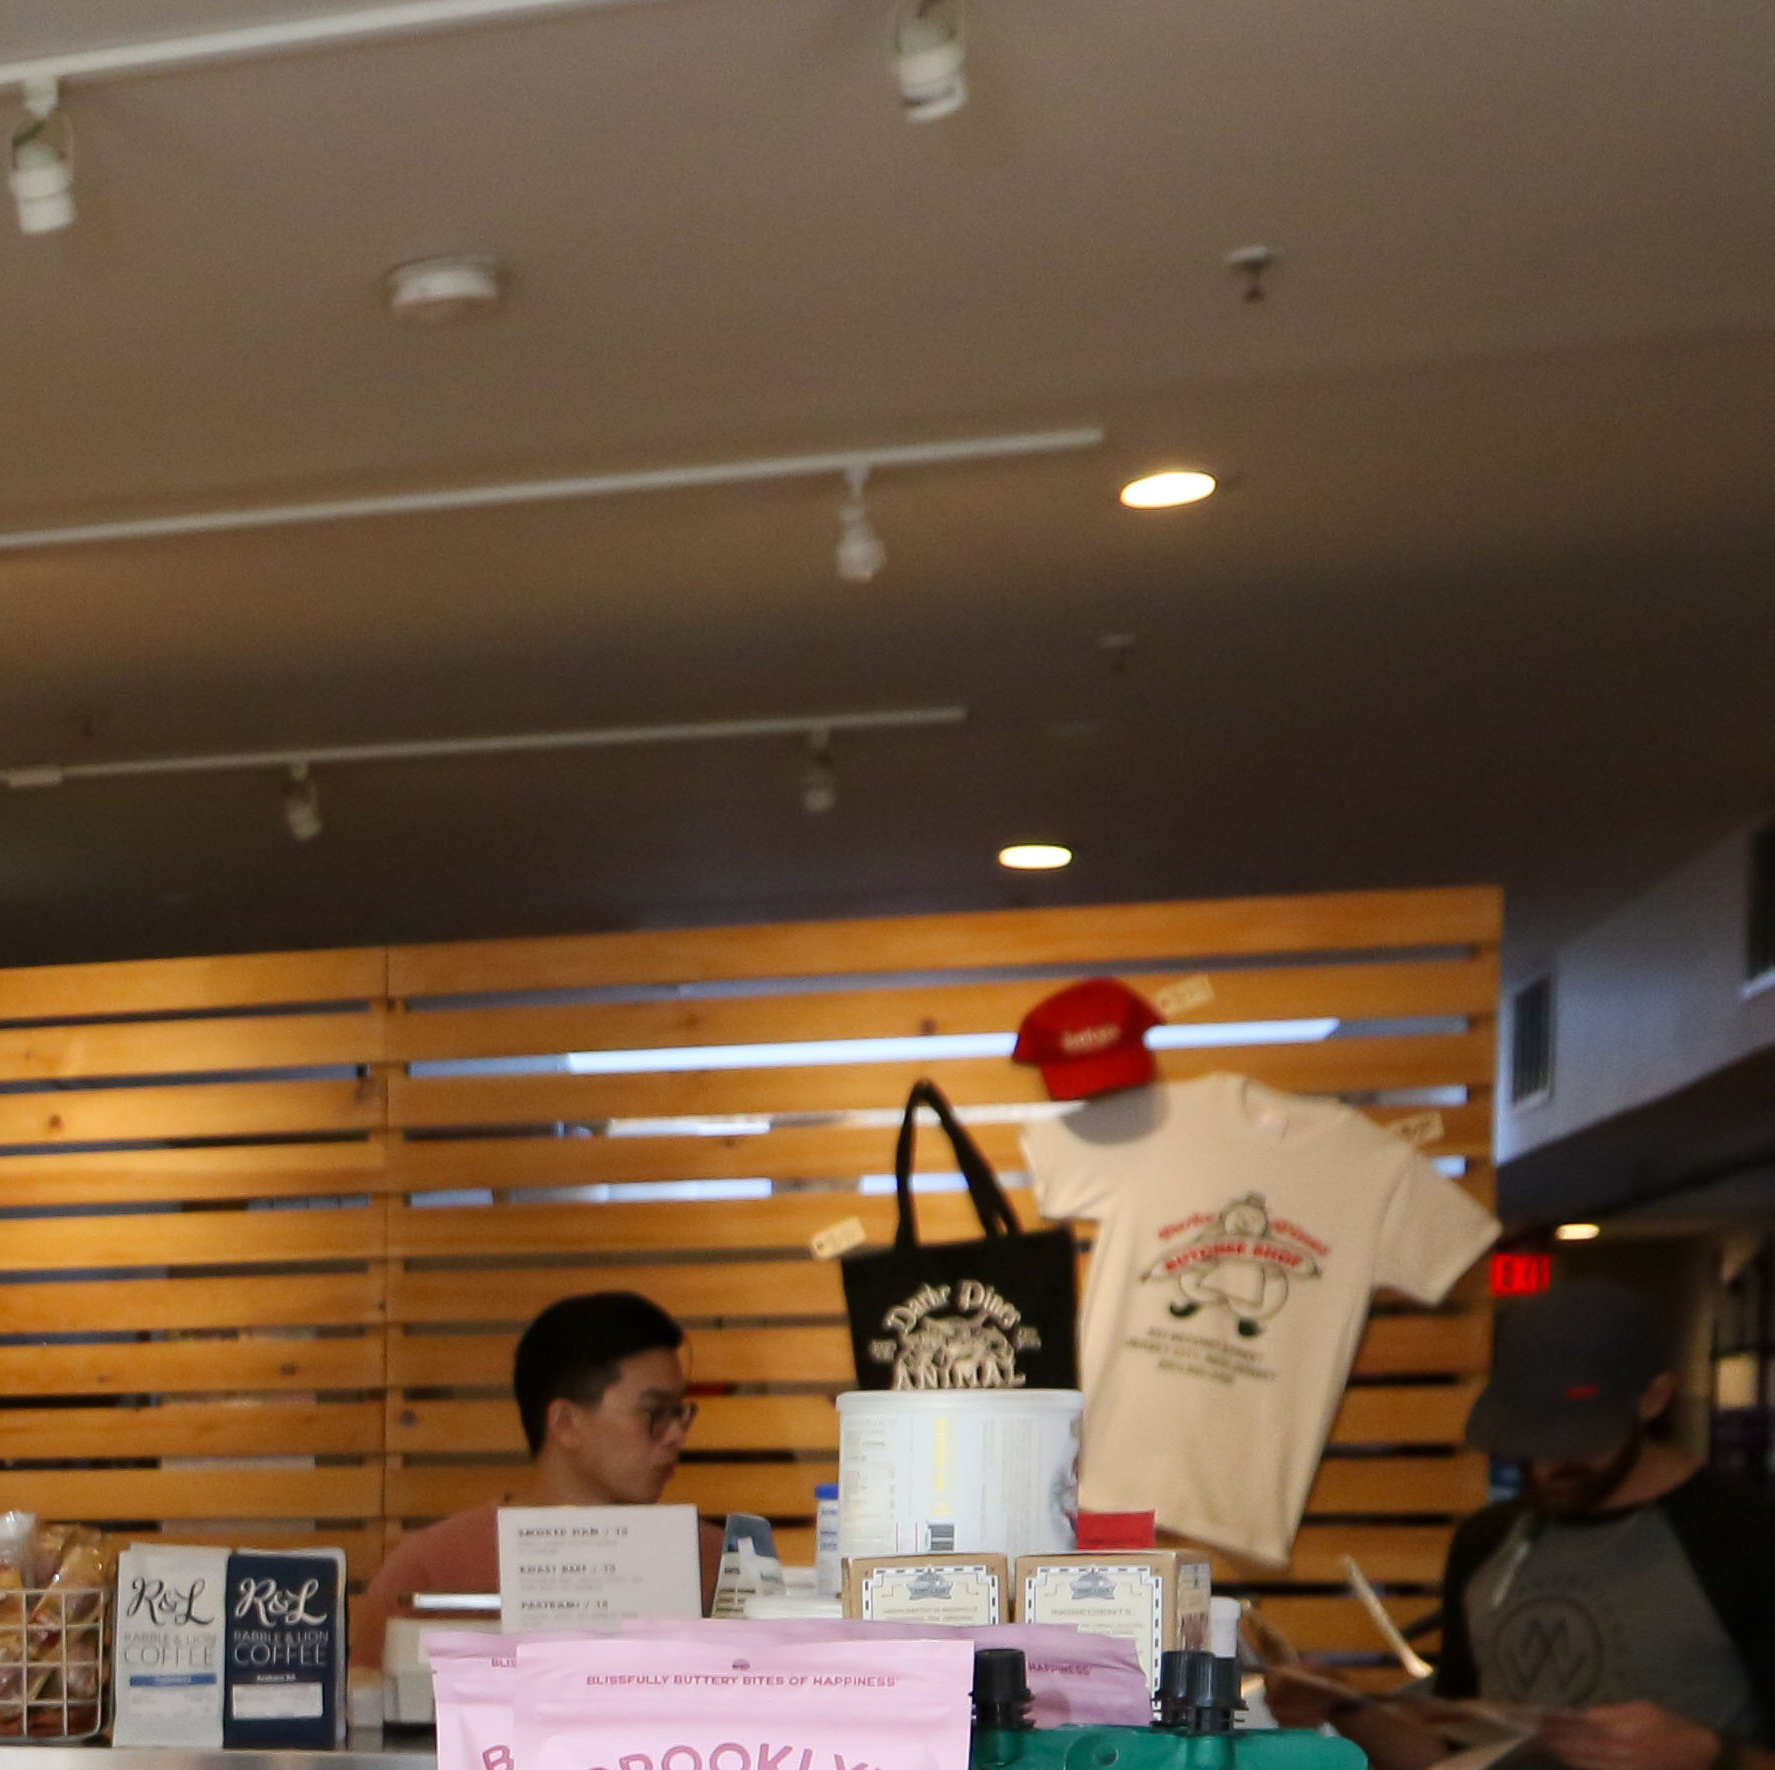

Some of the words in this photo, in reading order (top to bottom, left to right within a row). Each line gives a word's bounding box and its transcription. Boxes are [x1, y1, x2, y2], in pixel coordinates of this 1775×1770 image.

[234, 1644, 328, 1665] COFFEE
[586, 1674, 670, 1686] BLISSFULLY
[673, 1674, 739, 1687] BUTTERY
[742, 1676, 785, 1687] BITES
[789, 1676, 807, 1687] OF
[812, 1676, 897, 1688] HAPPINESS
